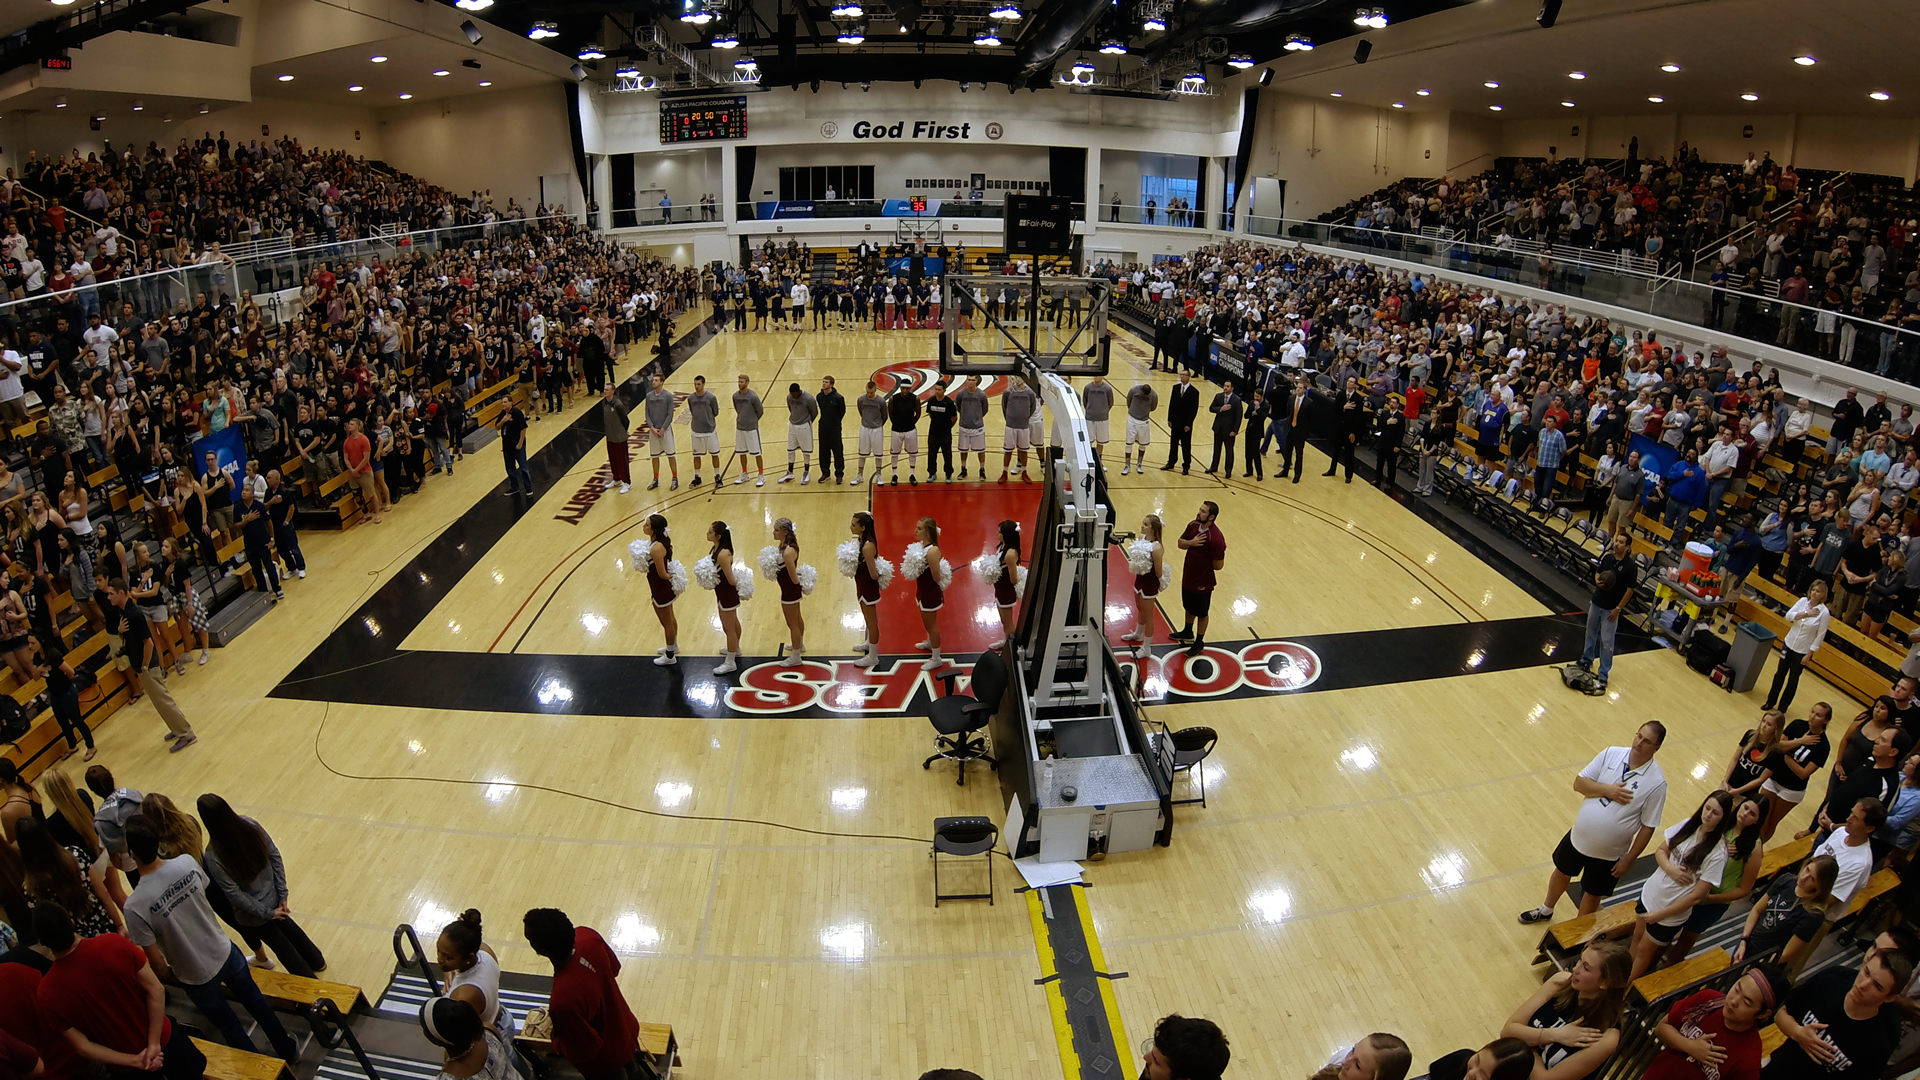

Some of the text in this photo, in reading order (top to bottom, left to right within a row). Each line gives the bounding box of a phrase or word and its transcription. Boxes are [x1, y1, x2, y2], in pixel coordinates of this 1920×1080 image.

[852, 121, 970, 139] God First
[913, 202, 925, 211] 35
[1026, 219, 1056, 229] Fair-Play
[1218, 358, 1245, 379] CHAMPIONS
[1227, 354, 1244, 369] BASKETB
[1641, 467, 1661, 485] CAA
[724, 641, 1322, 714] COUARS
[149, 869, 196, 915] NUTRISHOP
[162, 885, 199, 918] GLENDORA CA
